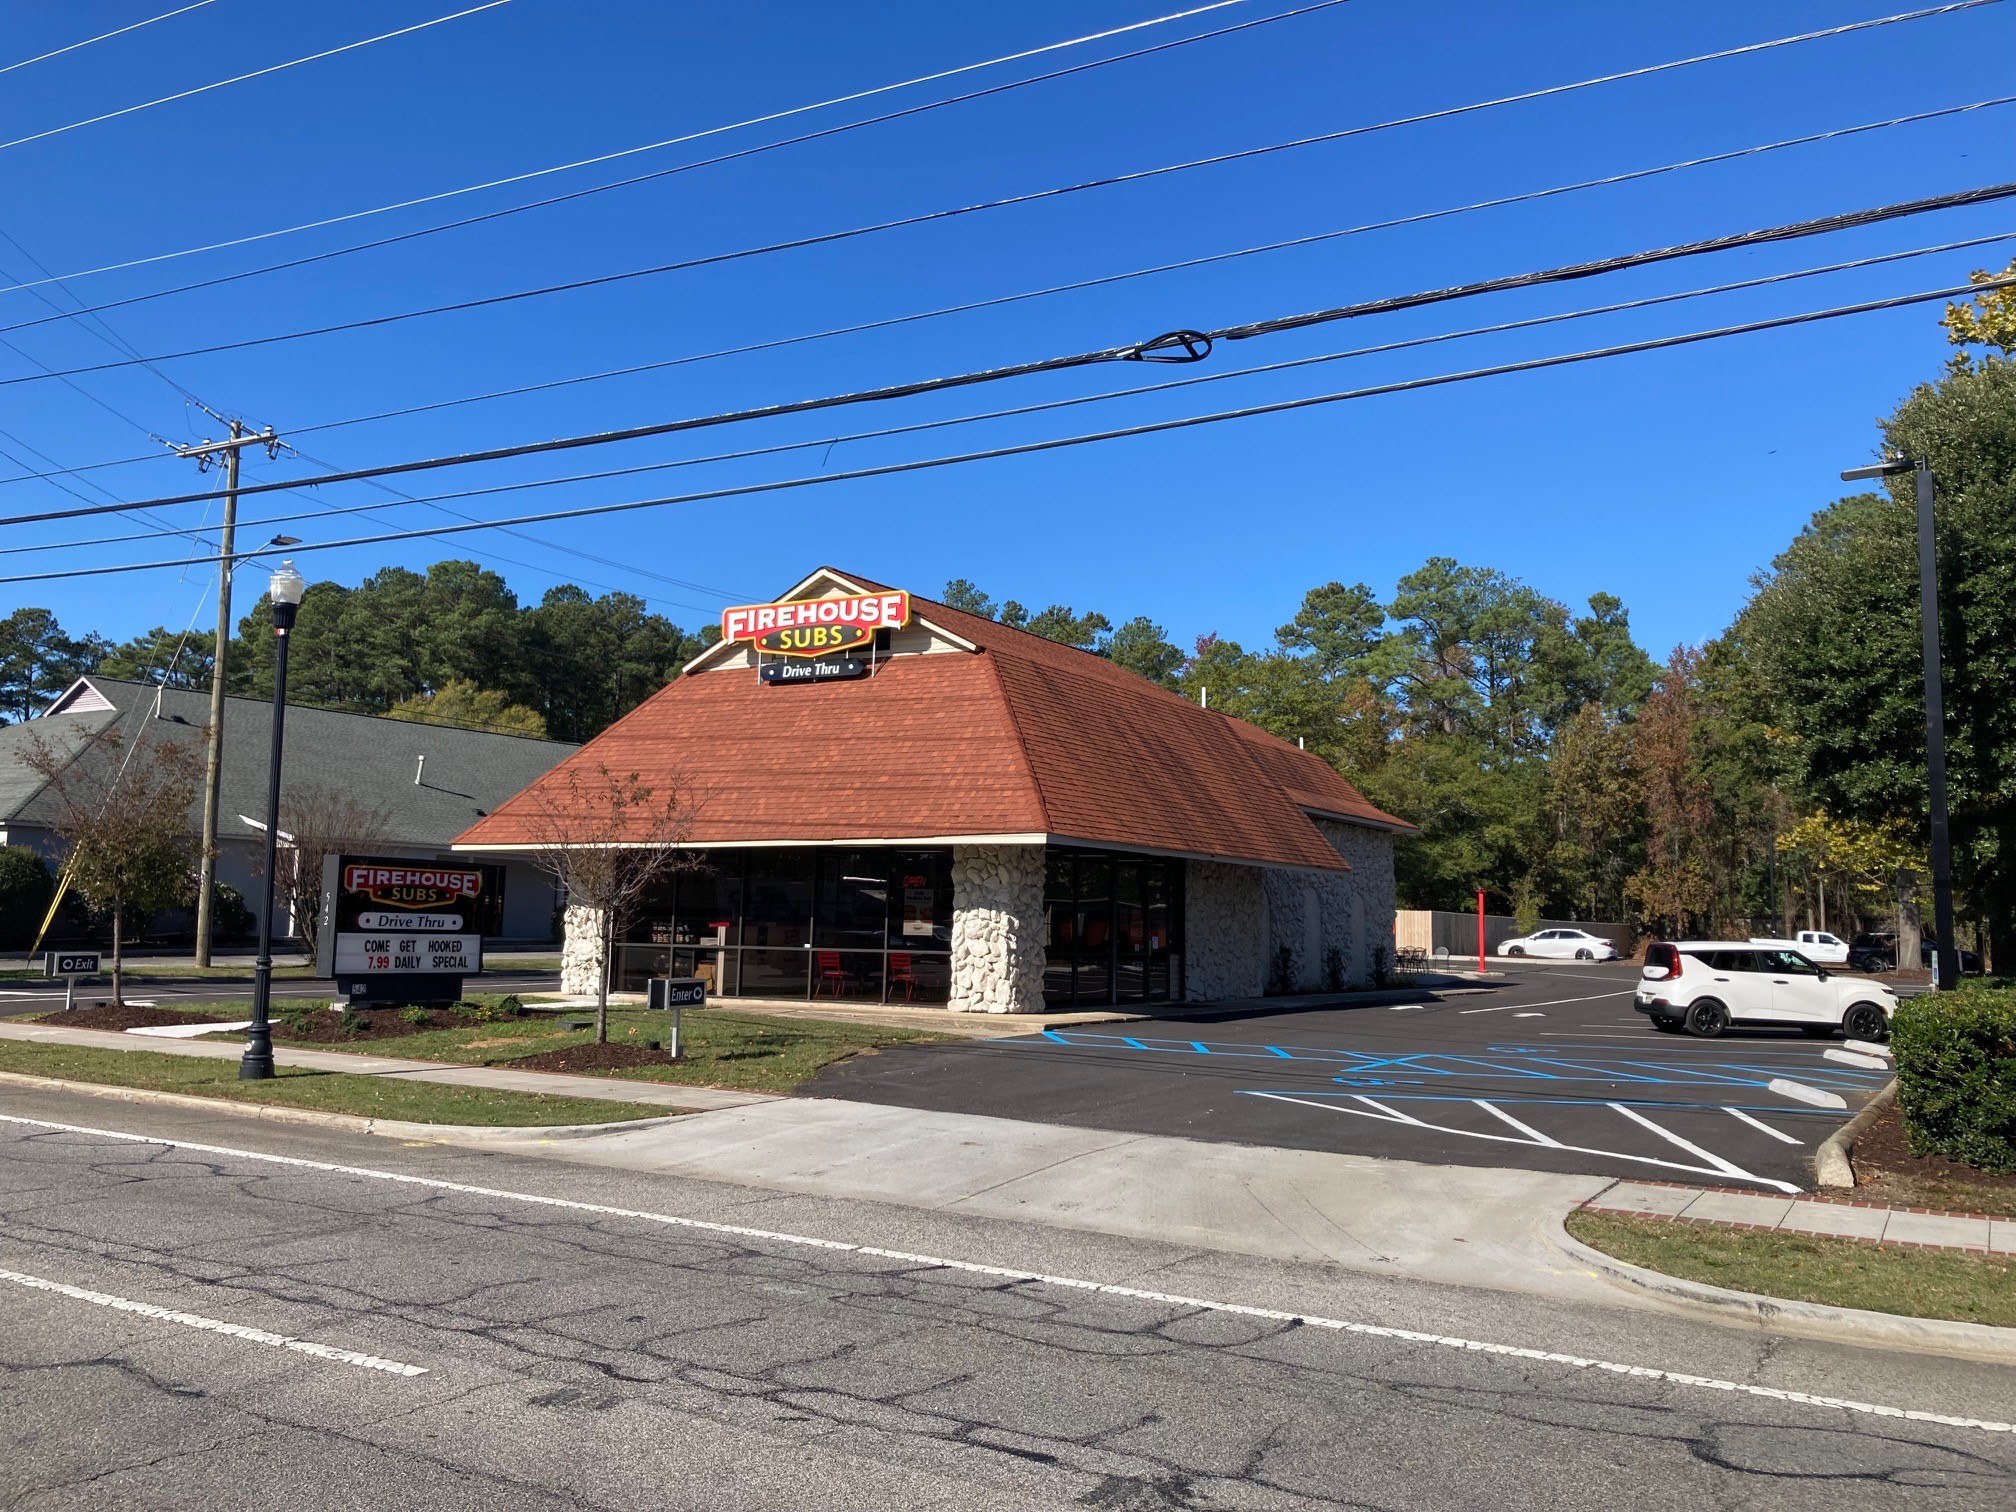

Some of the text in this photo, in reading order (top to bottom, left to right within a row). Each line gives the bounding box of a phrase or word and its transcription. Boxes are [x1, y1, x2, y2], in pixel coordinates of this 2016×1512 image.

[728, 594, 902, 645] FIREHOUSE
[780, 625, 843, 650] SUBS
[782, 662, 840, 678] Drive Thru
[352, 869, 476, 896] FIREHOUSE
[903, 875, 927, 887] OPEN
[391, 887, 437, 901] SUBS
[378, 915, 445, 928] Drive Thru
[364, 940, 463, 953] COME GET HOOKED
[74, 958, 95, 970] Exit
[368, 955, 469, 970] 7.99 DAILY SPECIAL
[671, 987, 694, 1002] Enter
